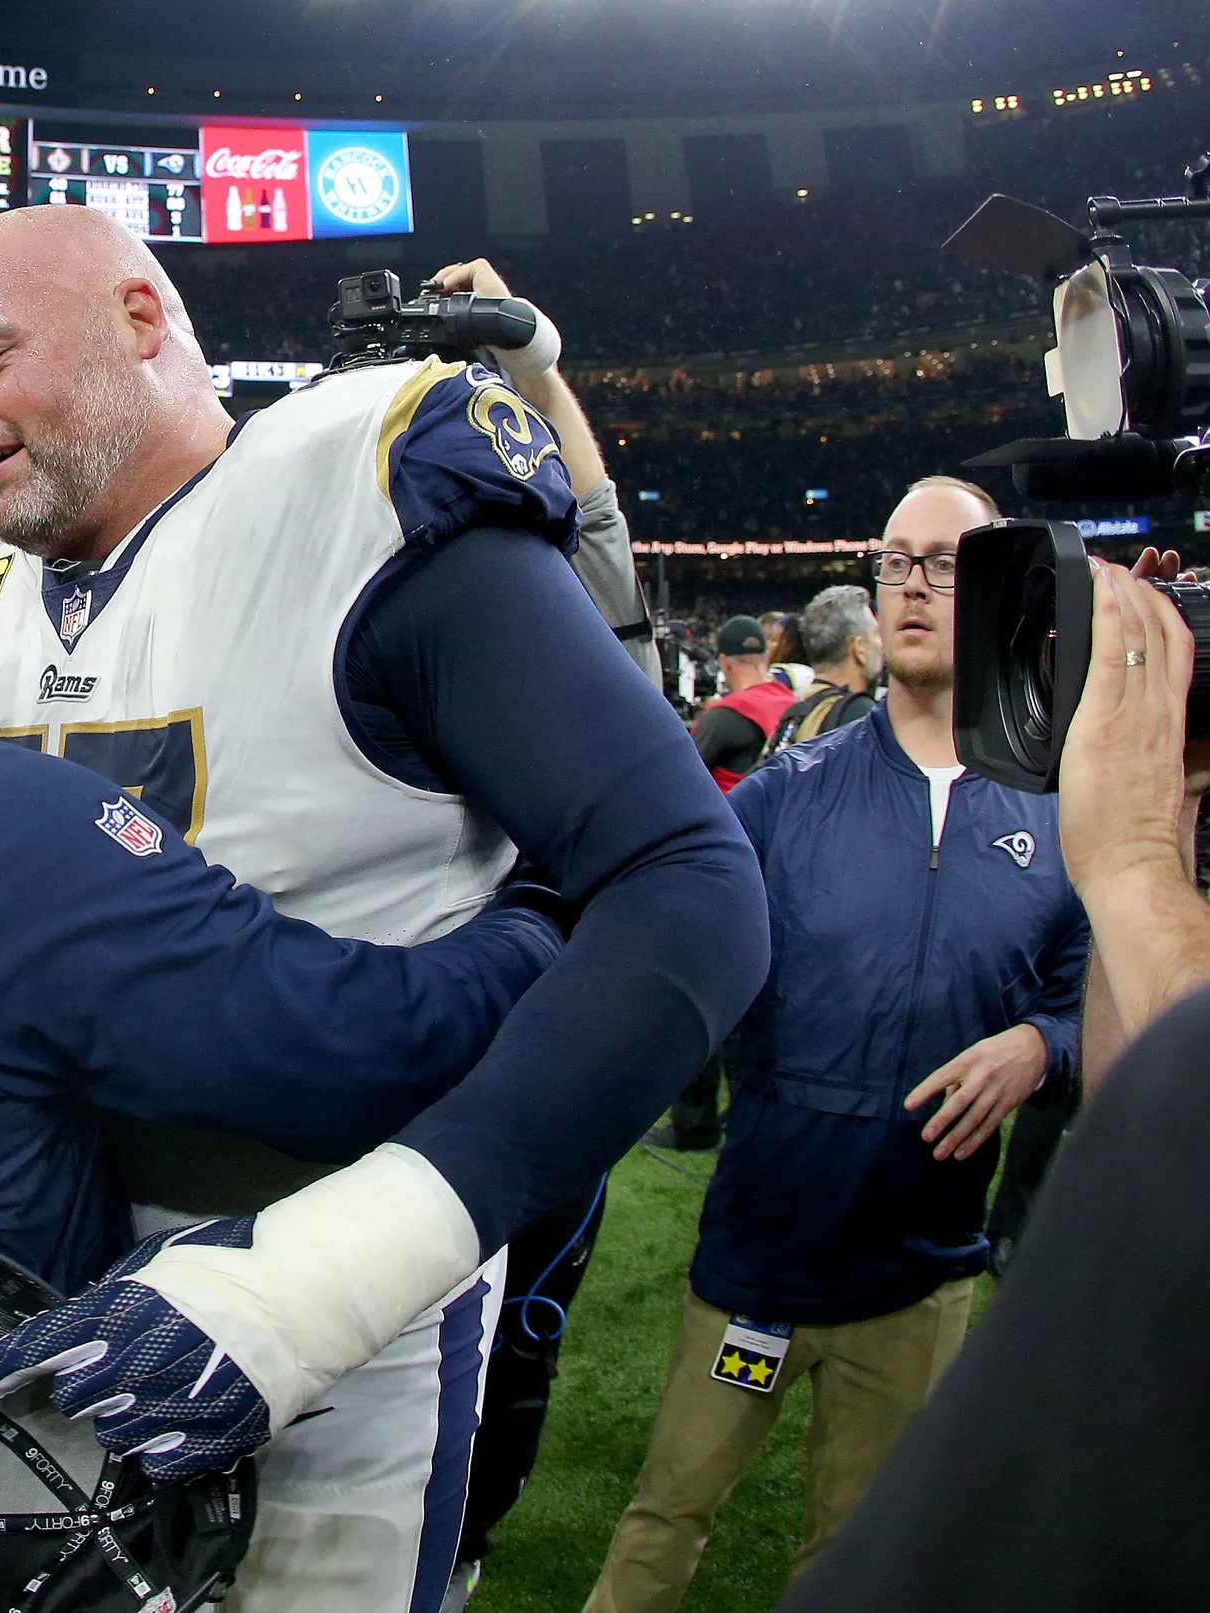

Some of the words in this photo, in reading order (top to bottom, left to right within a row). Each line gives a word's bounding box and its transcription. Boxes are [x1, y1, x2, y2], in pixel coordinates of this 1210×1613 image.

[103, 154, 129, 175] VS
[63, 610, 85, 634] NFL
[39, 663, 99, 701] Rams
[120, 819, 155, 849] NFL
